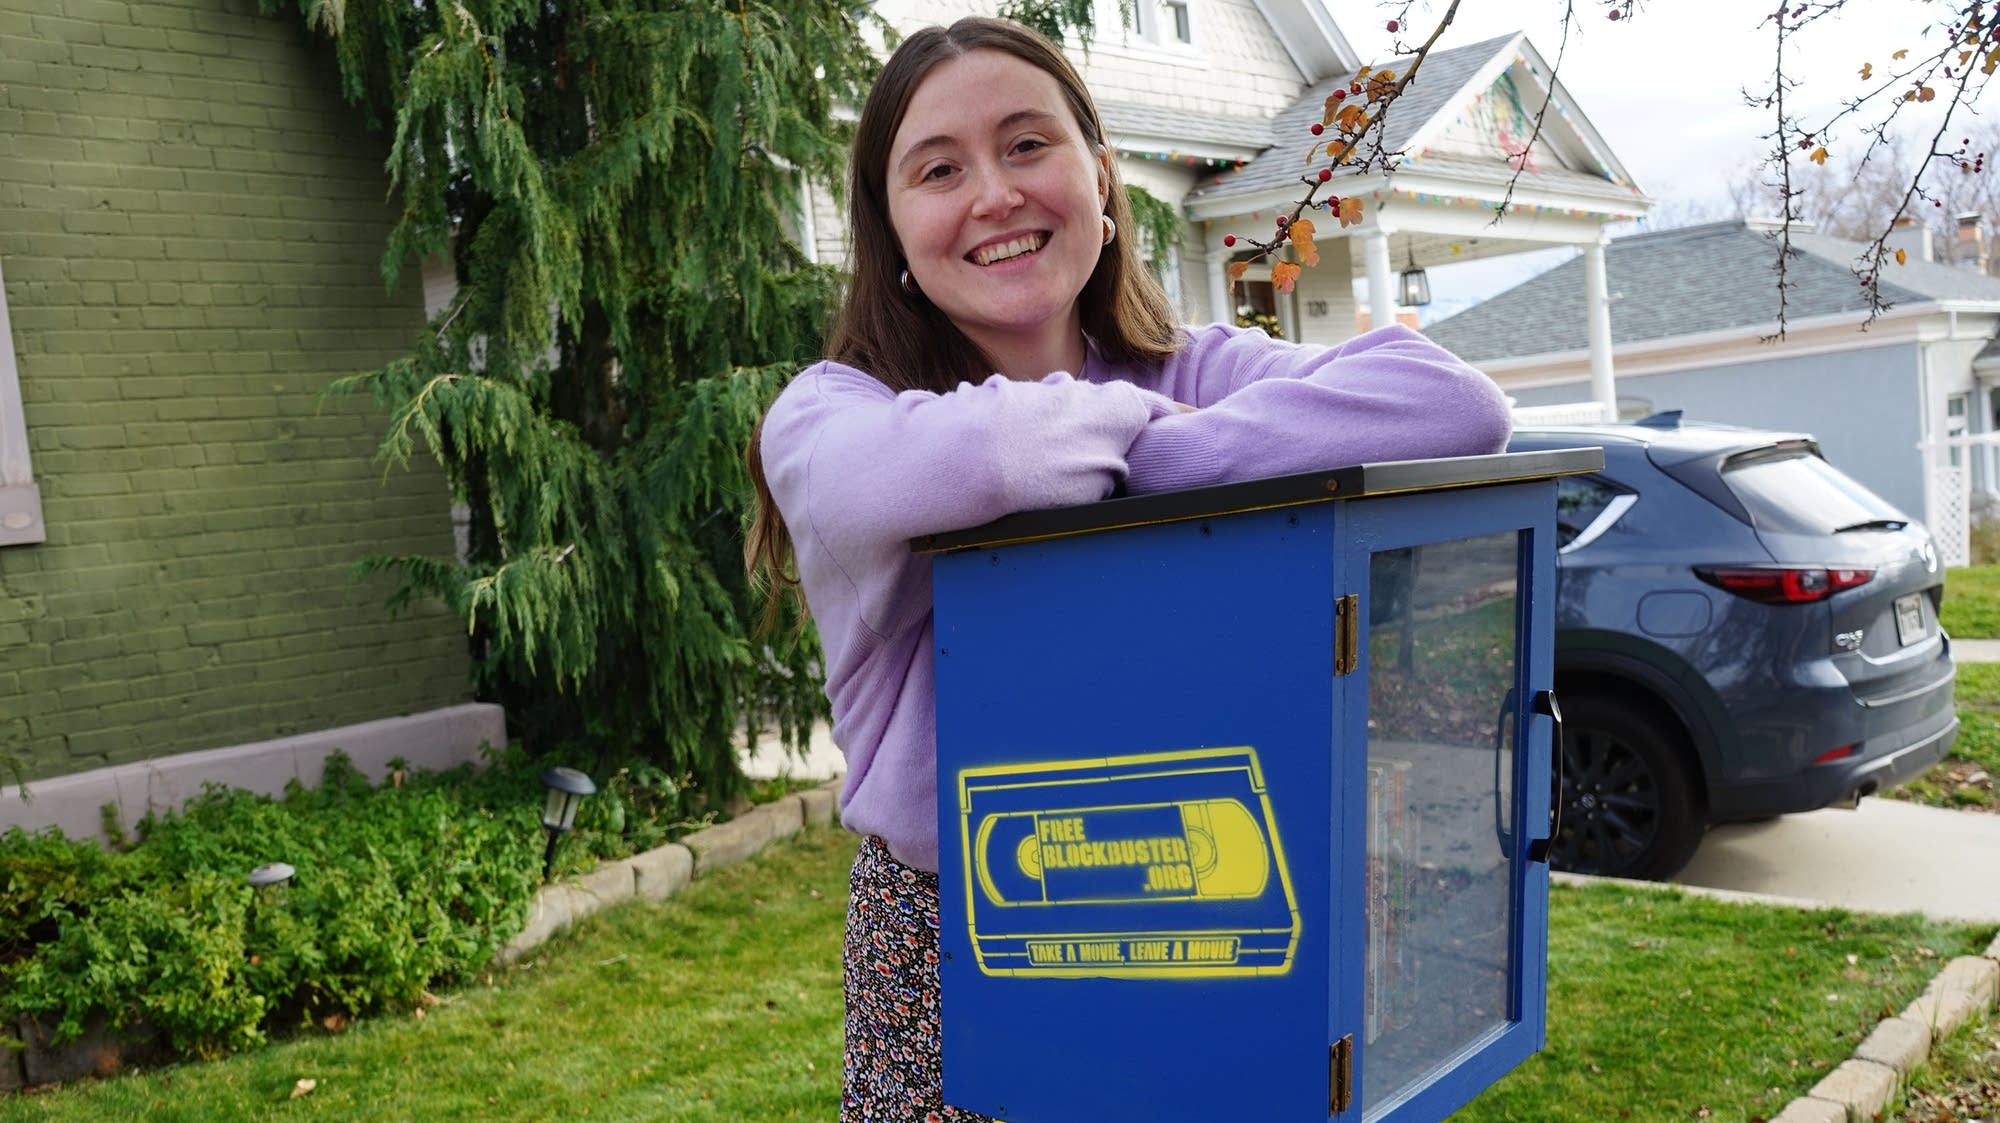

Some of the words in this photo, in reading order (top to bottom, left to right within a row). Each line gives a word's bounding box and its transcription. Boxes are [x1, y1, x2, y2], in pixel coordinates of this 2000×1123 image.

[1040, 818, 1085, 842] FREE
[1042, 838, 1188, 868] BLOCKBUSTER
[1143, 864, 1193, 891] .ORG
[1031, 944, 1063, 962] TAKE
[1067, 944, 1077, 961] A
[1079, 943, 1125, 962] MOVIE,
[1129, 942, 1168, 961] LEAVE
[1172, 941, 1183, 960] A
[1187, 940, 1233, 960] MOVIE
